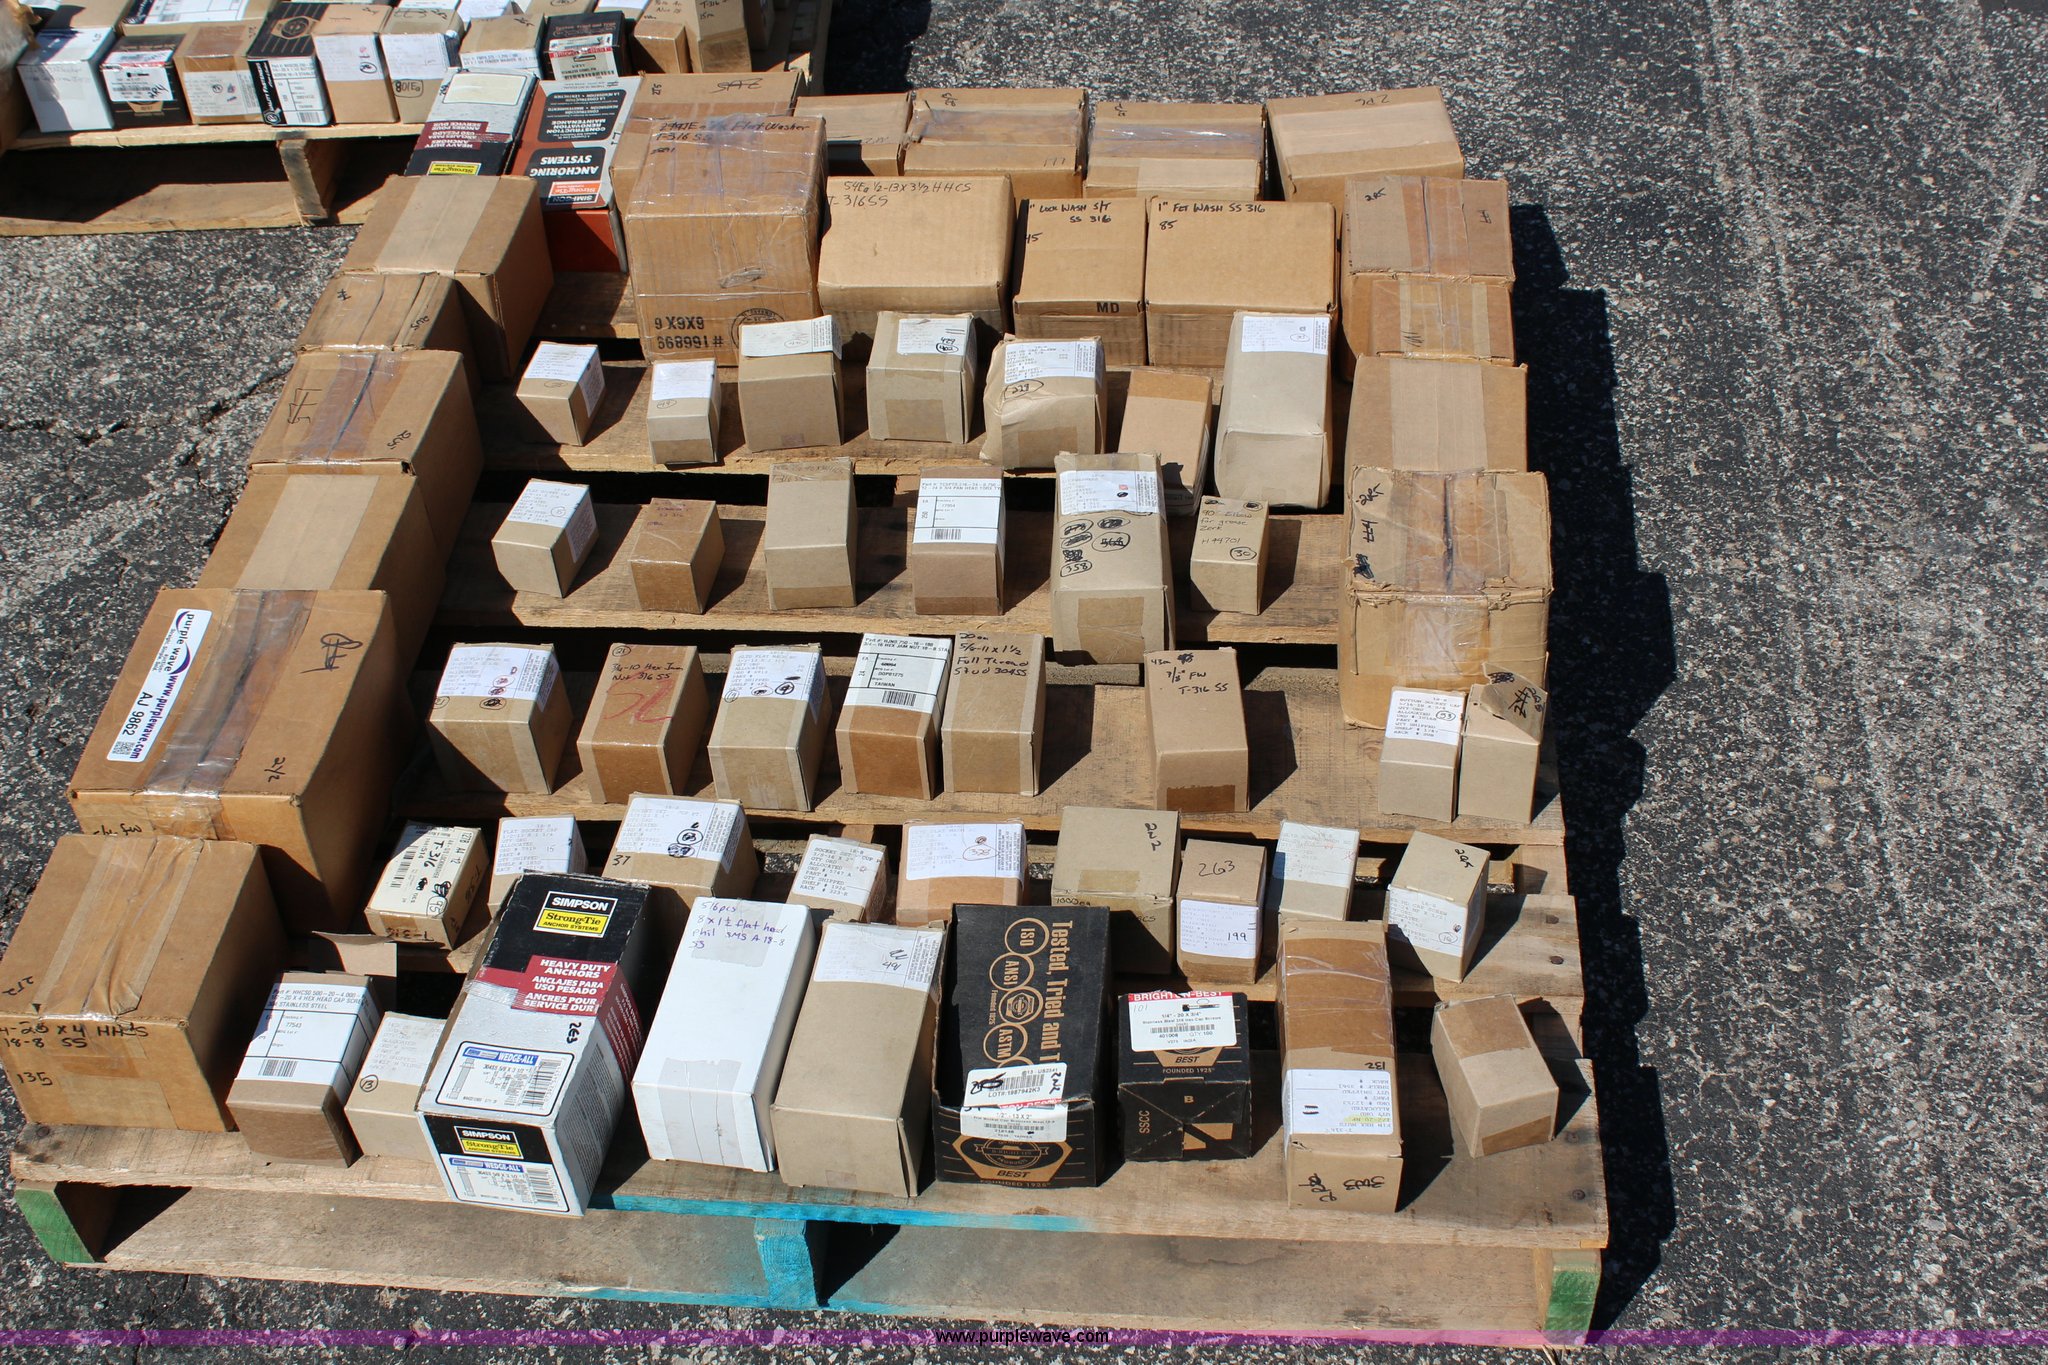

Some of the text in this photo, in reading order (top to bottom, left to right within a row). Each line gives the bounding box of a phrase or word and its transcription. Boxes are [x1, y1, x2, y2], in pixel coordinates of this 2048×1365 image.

[546, 126, 606, 134] CONSTRUCTION
[540, 154, 592, 164] SYSTEMS
[529, 166, 599, 177] ANCHORING
[1061, 203, 1087, 212] WASH
[1193, 203, 1223, 212] WASH
[1229, 203, 1243, 212] SS
[1247, 203, 1266, 213] 316
[1069, 214, 1112, 223] SS 316
[1159, 219, 1177, 231] 85
[1096, 301, 1120, 314] MD
[1234, 549, 1251, 558] 30
[1066, 562, 1088, 573] 358
[162, 613, 195, 673] purple wave
[957, 656, 980, 665] Full
[639, 672, 653, 680] 316
[1189, 671, 1207, 680] FW
[1178, 682, 1229, 695] T-316 SS
[122, 692, 154, 736] AJ 9862
[129, 673, 178, 760] www.purplewave.com
[423, 840, 445, 868] T-316
[612, 855, 630, 867] 37
[809, 861, 843, 871] ALLOCATED
[817, 877, 845, 886] SHIPPED
[429, 900, 444, 913] 95
[551, 897, 609, 911] SIMPSON
[546, 912, 601, 926] Strong-Tie
[735, 919, 787, 934] flat head
[692, 927, 716, 937] phil
[763, 936, 786, 946] 18-8
[1019, 927, 1036, 947] ISO
[1227, 932, 1248, 942] 199
[540, 959, 611, 972] HEAVY DUTY
[544, 967, 600, 979] ANCHORS
[1003, 959, 1020, 985] ANSI
[532, 976, 604, 989] ANCLAJES PARA
[1040, 920, 1073, 1051] Tested, Tried and
[534, 983, 597, 995] USO PESADO
[525, 992, 597, 1005] ANCRES POUR
[278, 1001, 310, 1009] STAINLESS
[522, 1000, 594, 1012] SERVICE DUR
[1132, 1004, 1149, 1013] 101
[4, 1036, 88, 1048] 18-8 SS
[997, 1028, 1013, 1059] ASTM
[497, 1051, 536, 1064] WEDGE-ALL
[1175, 1056, 1200, 1064] BEST
[18, 1072, 53, 1086] 135
[1184, 1094, 1194, 1104] B
[1139, 1109, 1150, 1134] SSCC
[462, 1129, 511, 1141] SIMPSON
[484, 1162, 521, 1172] WEDGE-ALL
[996, 1170, 1031, 1178] BEST
